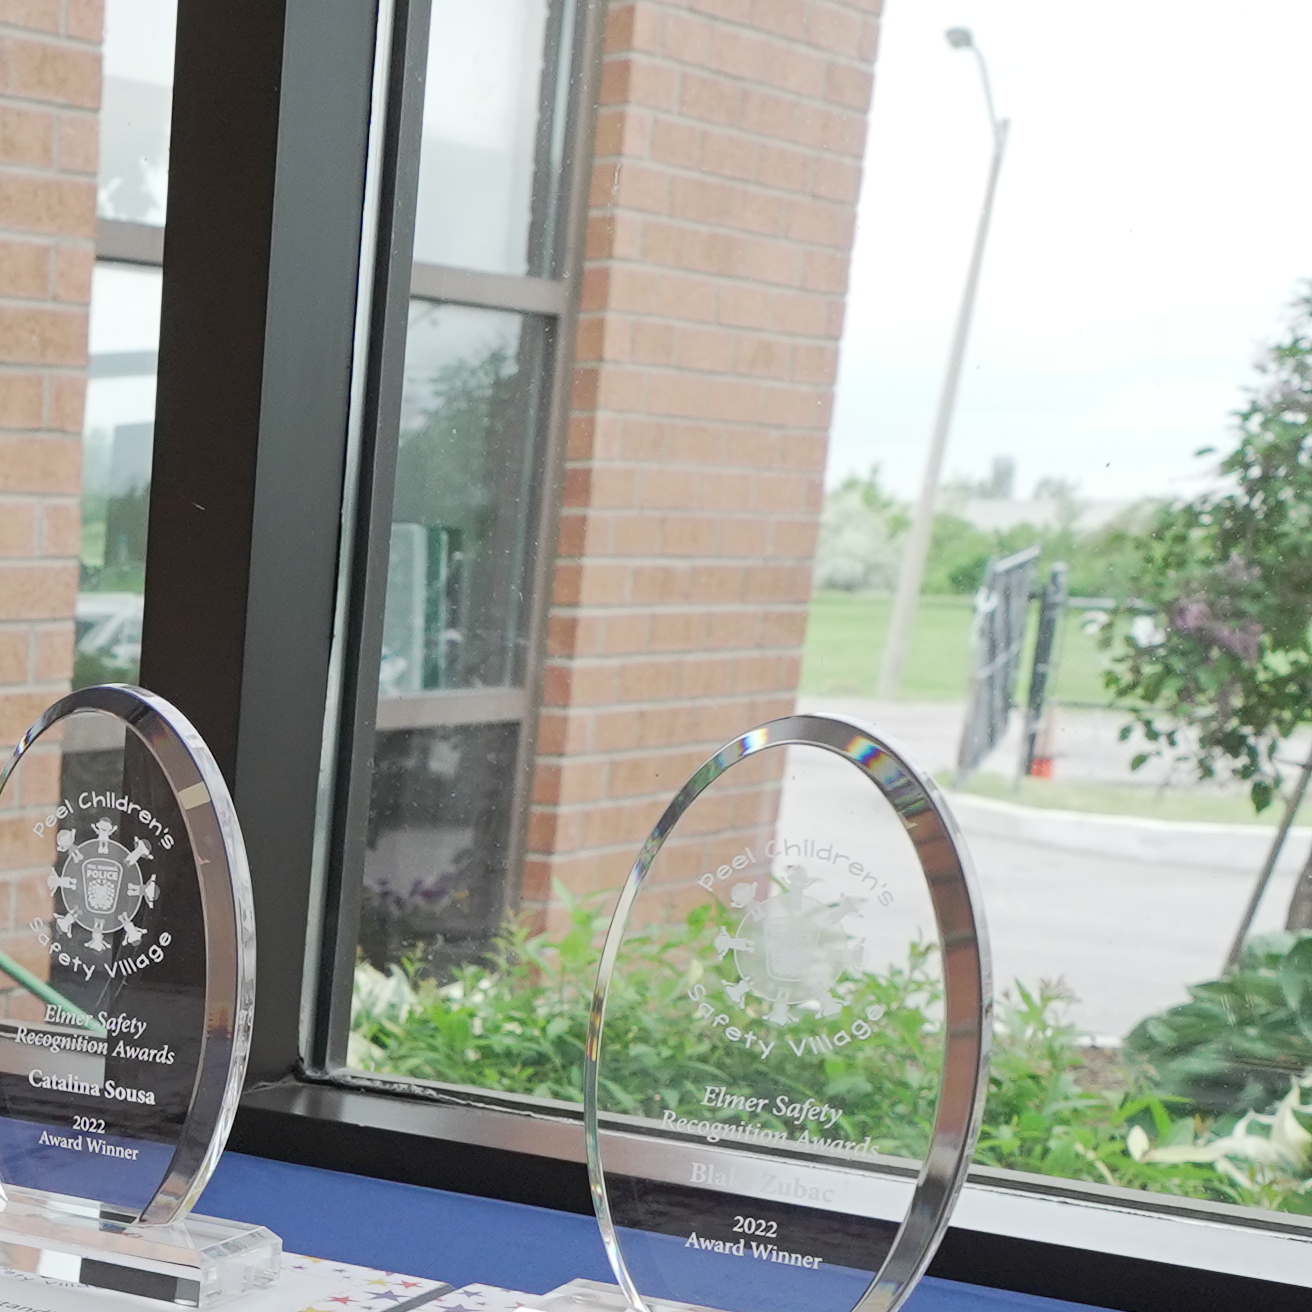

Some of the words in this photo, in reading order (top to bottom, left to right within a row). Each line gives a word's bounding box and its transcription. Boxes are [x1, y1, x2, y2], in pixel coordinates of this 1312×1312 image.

[32, 799, 74, 838] Peel
[78, 791, 175, 850] Children's
[86, 869, 118, 880] POLICE
[697, 847, 756, 893] Peel
[765, 838, 894, 908] Children's
[29, 916, 96, 981] Safety
[105, 931, 173, 979] Village
[44, 1004, 94, 1028] Elmer
[97, 1011, 147, 1039] Safety
[687, 983, 775, 1059] Safety
[788, 1003, 885, 1059] Village
[14, 1026, 108, 1056] Recognition
[113, 1039, 175, 1065] Awards
[28, 1068, 101, 1096] Catalina
[104, 1080, 156, 1106] Sousa
[700, 1085, 769, 1112] Elmer
[773, 1095, 844, 1128] Safety
[72, 1115, 106, 1134] 2022
[661, 1110, 788, 1145] Recognition
[793, 1130, 880, 1161] Awards
[39, 1130, 83, 1151] Award
[86, 1138, 140, 1161] Winner
[760, 1172, 834, 1202] Zubac
[732, 1215, 778, 1238] 2022
[685, 1231, 745, 1257] Award
[750, 1241, 823, 1270] Winner
